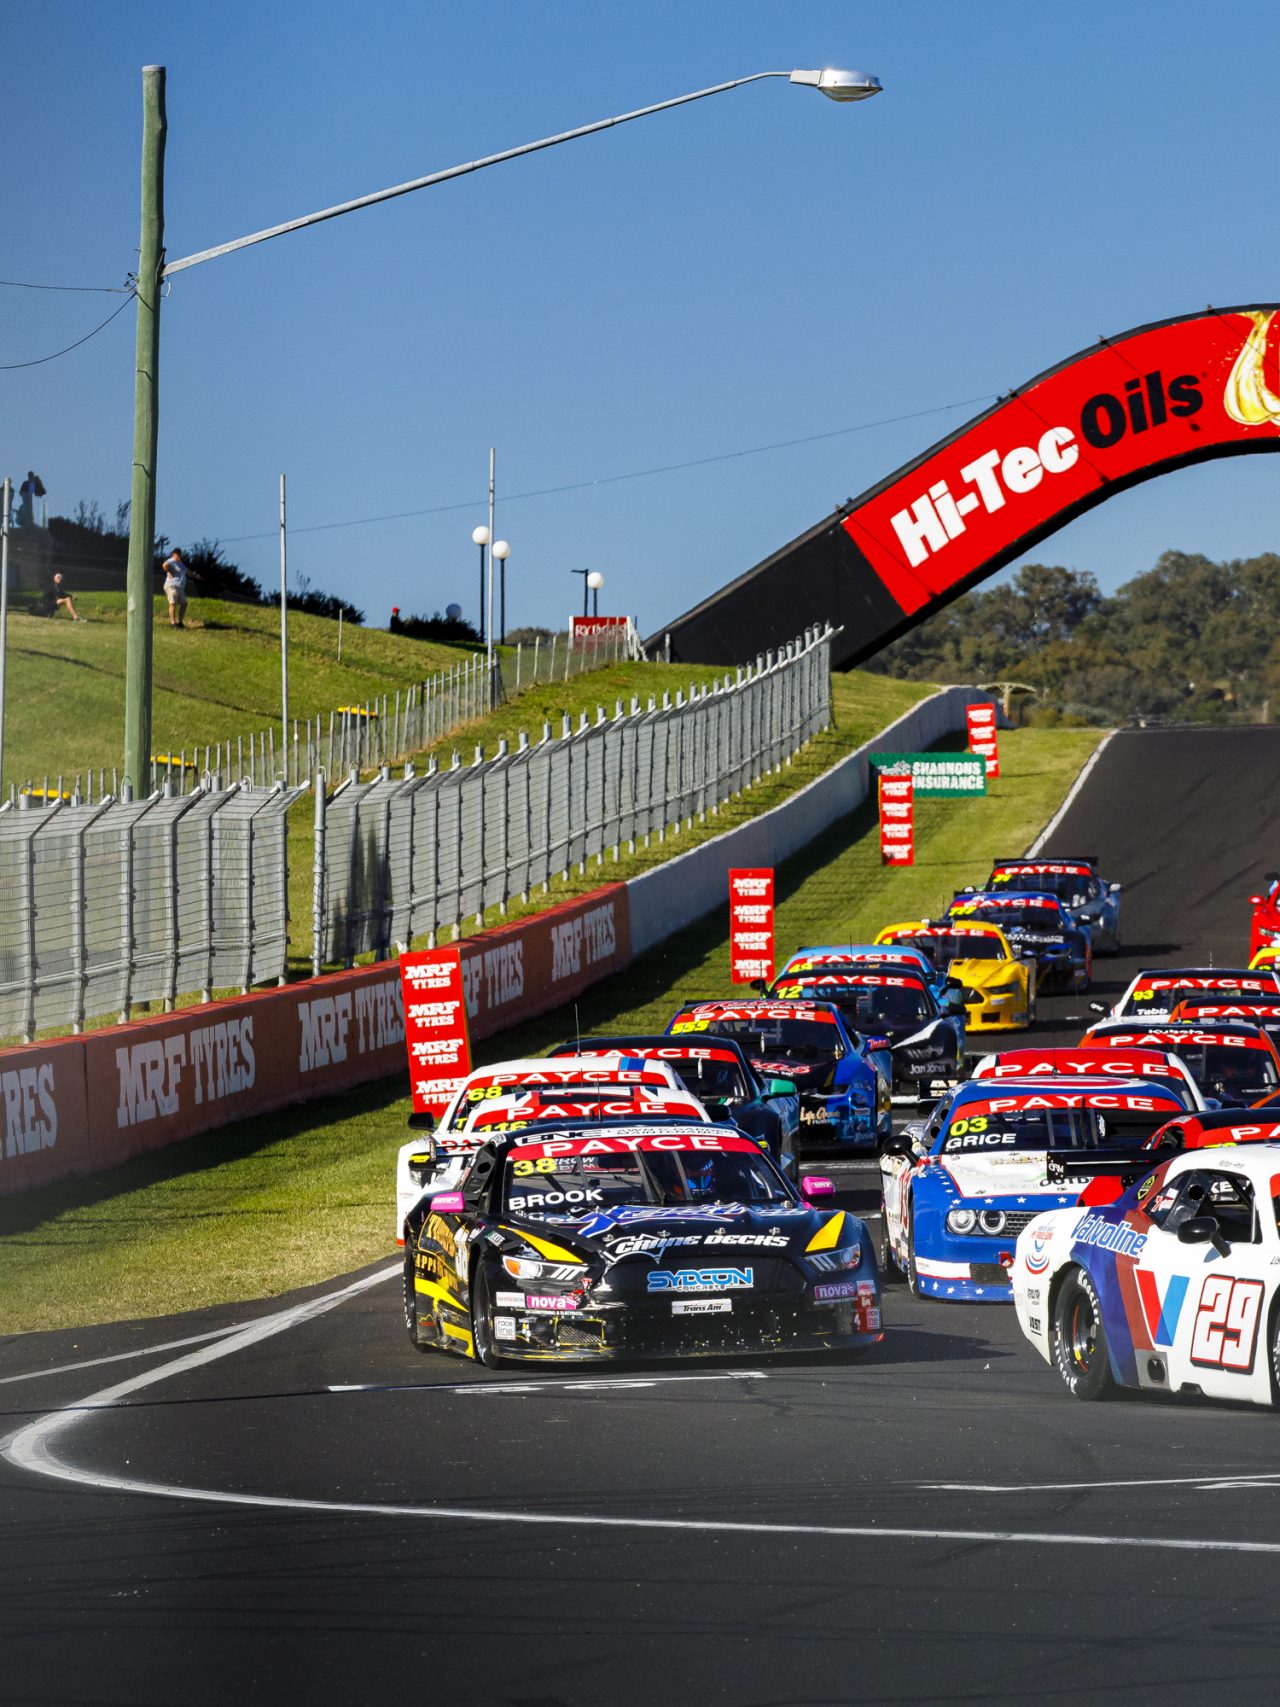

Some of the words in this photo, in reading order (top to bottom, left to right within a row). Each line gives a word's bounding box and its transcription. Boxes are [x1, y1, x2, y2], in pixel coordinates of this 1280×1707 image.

[890, 426, 1079, 567] Hi-Tec
[1081, 370, 1204, 448] Oils
[912, 762, 981, 775] SHANNONS
[912, 776, 984, 789] INSURANCE
[897, 928, 984, 937] PAYCE
[551, 917, 583, 982] MRF
[584, 902, 616, 965] TYRES
[807, 954, 903, 965] PAYCE
[405, 962, 456, 979] MRF
[412, 977, 451, 990] TYRES
[460, 954, 482, 1019] RF
[484, 939, 524, 1009] TYRES
[797, 976, 904, 986] PAYCE
[1151, 979, 1261, 990] PAYCE
[777, 985, 804, 999] 12
[1133, 990, 1154, 1001] 93
[408, 1001, 460, 1018] MRF
[694, 1010, 816, 1022] PAYCE
[415, 1015, 454, 1028] TYRES
[298, 992, 352, 1073] MRF
[412, 1039, 463, 1056] MRF
[1110, 1036, 1246, 1046] PAYCE
[419, 1053, 458, 1066] TYRES
[575, 1048, 711, 1059] PAYCE
[116, 1039, 186, 1128] MRF
[191, 1015, 256, 1102] TYRES
[995, 1063, 1169, 1077] PAYCE
[492, 1070, 642, 1086] PAYCE
[468, 1086, 503, 1101] 68
[0, 1063, 57, 1159] RES
[507, 1102, 667, 1120] PAYCE
[989, 1096, 1154, 1112] PAYCE
[950, 1117, 988, 1136] 03
[542, 1136, 723, 1157] PAYCE
[946, 1134, 1016, 1149] GRICE
[513, 1157, 557, 1176] 38
[509, 1188, 603, 1211] BROOK
[704, 1235, 790, 1247] DECKS
[1071, 1215, 1148, 1257] Valvoline
[647, 1267, 754, 1291] SYDCON
[676, 1284, 726, 1292] CONCRETE
[819, 1286, 849, 1298] nova
[531, 1296, 566, 1309] nova
[683, 1303, 706, 1312] Trans
[707, 1303, 722, 1311] Am
[1190, 1273, 1265, 1375] 29
